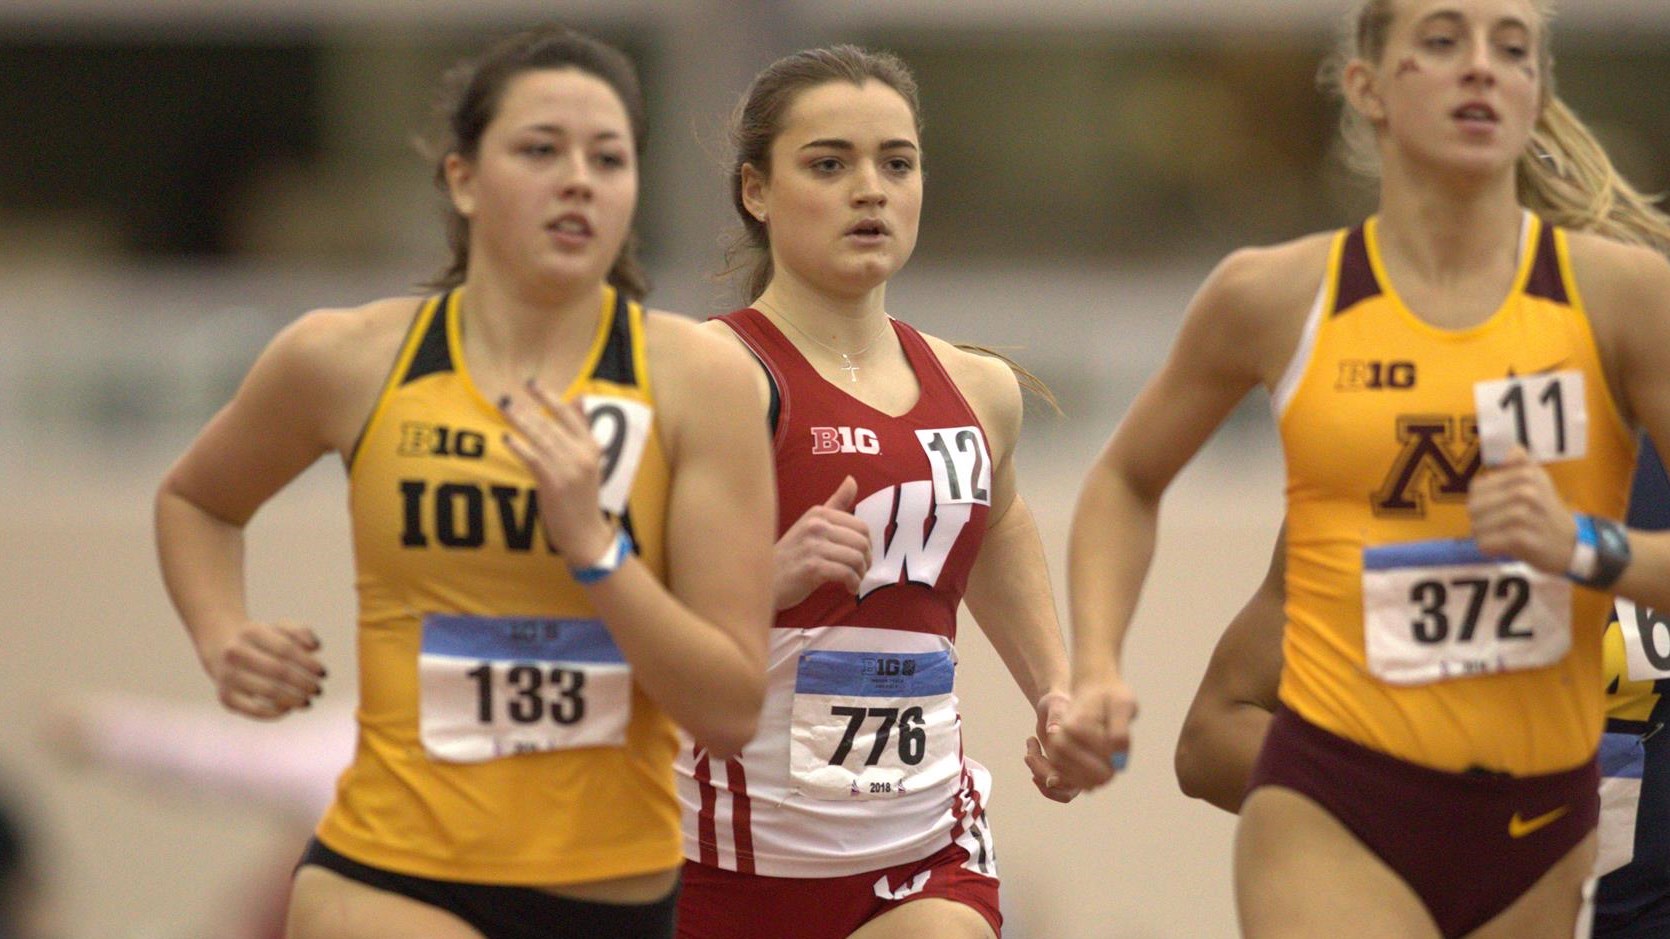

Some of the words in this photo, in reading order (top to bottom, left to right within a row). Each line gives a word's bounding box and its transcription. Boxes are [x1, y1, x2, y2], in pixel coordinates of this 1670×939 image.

[1500, 378, 1566, 455] 11
[928, 430, 988, 502] 12
[854, 480, 973, 603] W
[1410, 576, 1535, 645] 372
[467, 664, 585, 725] 133
[828, 706, 926, 766] 776
[870, 782, 892, 793] 2018
